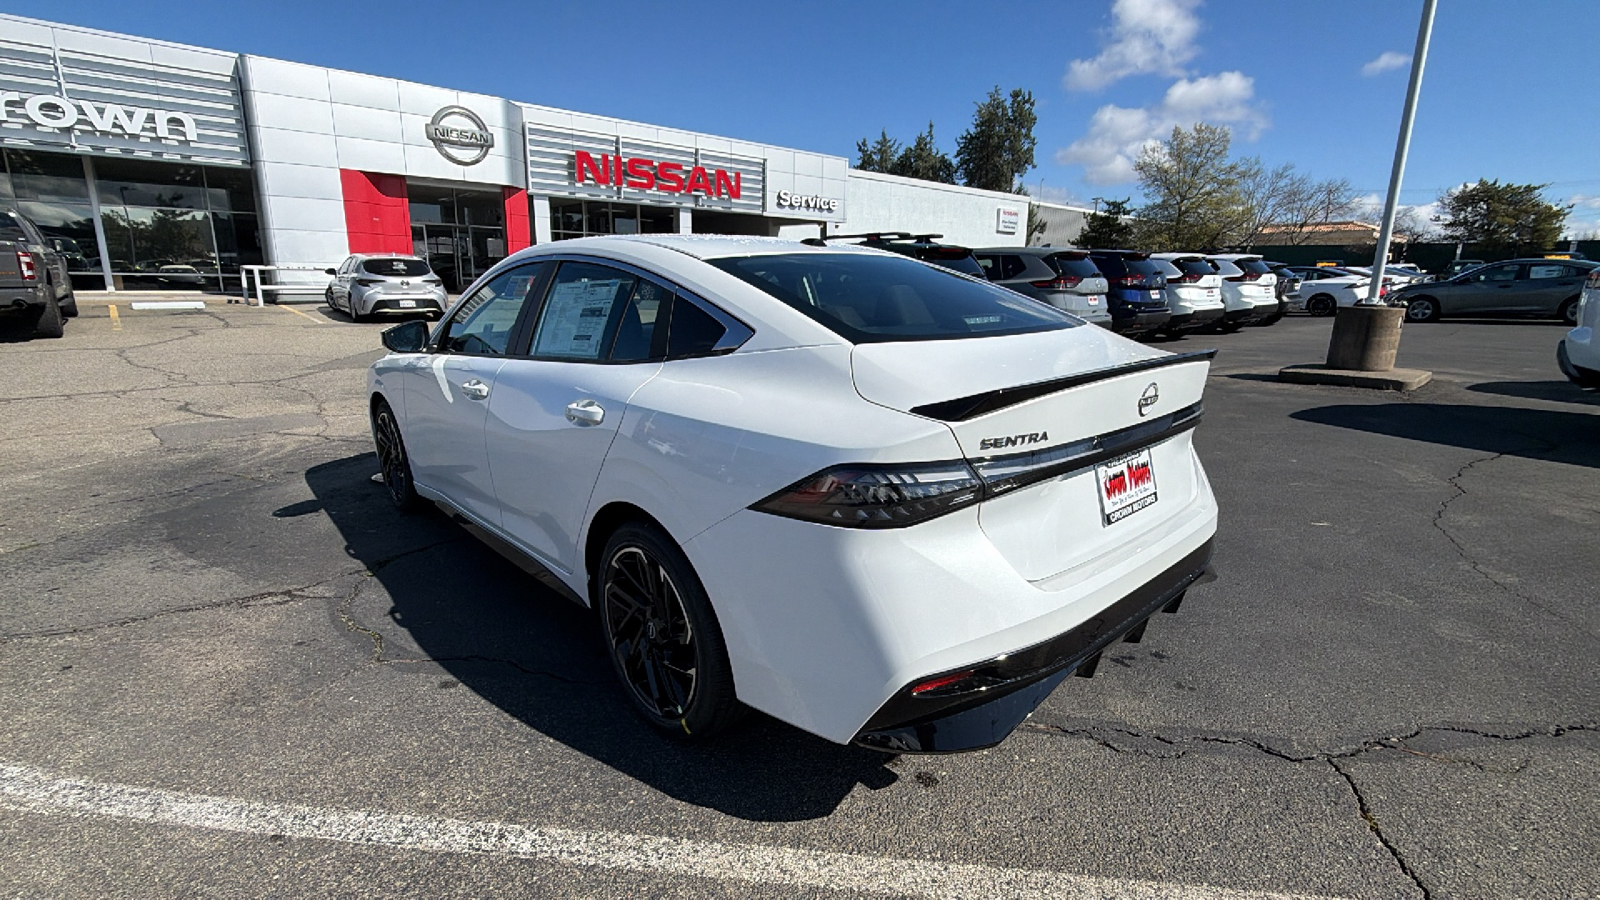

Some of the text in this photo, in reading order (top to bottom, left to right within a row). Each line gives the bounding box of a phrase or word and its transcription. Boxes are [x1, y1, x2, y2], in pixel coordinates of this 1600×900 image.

[0, 91, 198, 141] rown
[434, 127, 489, 144] NISSAN
[575, 150, 741, 199] NISSAN
[779, 190, 839, 210] Service
[979, 431, 1049, 450] SENTRA
[1109, 505, 1133, 522] CROWN
[1132, 494, 1156, 512] MOTORS
